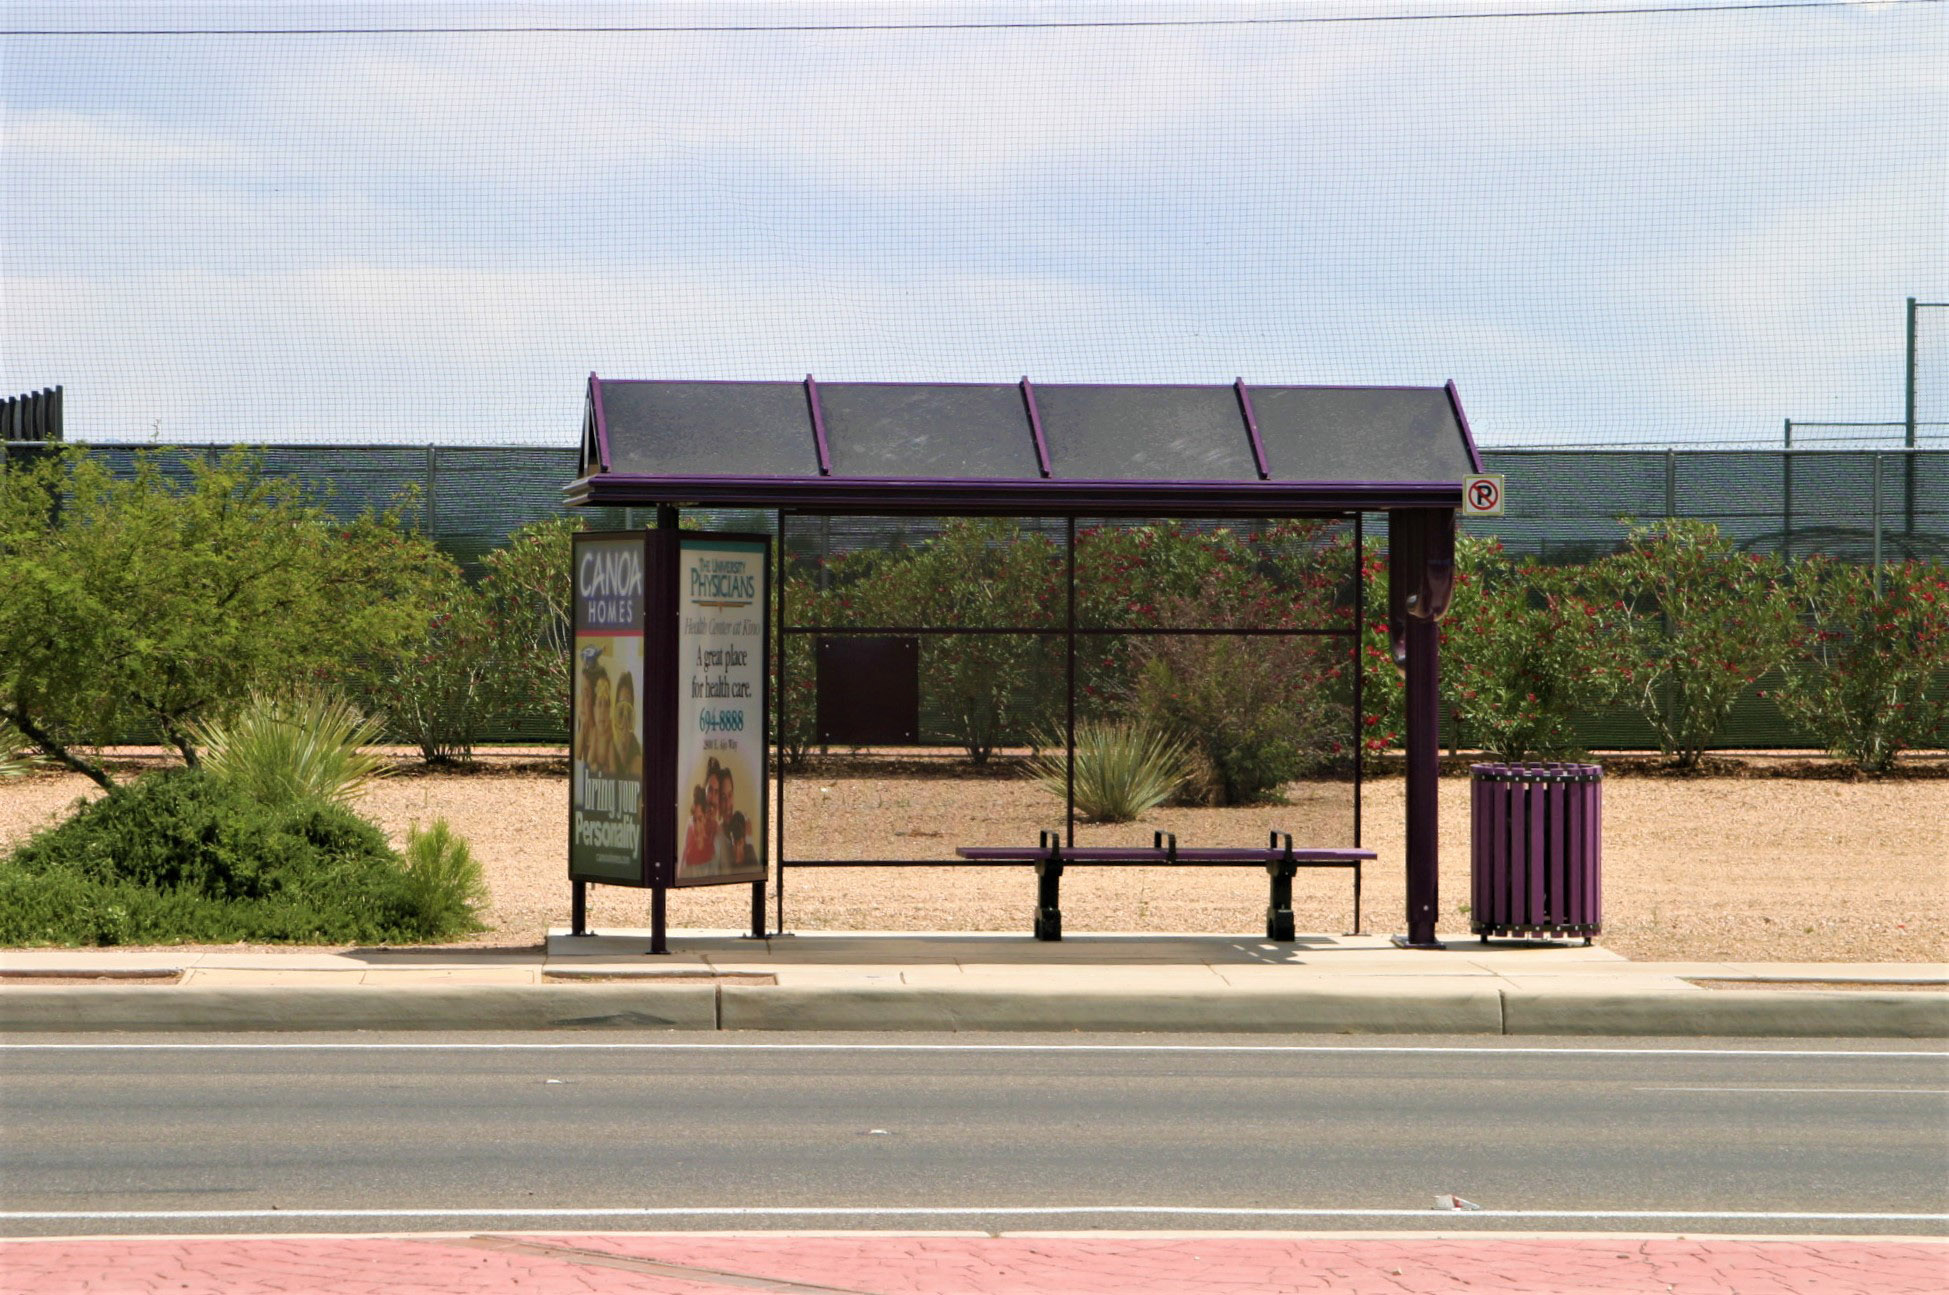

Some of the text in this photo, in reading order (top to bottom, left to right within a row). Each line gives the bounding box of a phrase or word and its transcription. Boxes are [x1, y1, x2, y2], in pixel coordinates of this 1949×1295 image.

[580, 551, 642, 597] CANOA
[699, 557, 746, 574] THE UNIVERSITY
[690, 567, 755, 598] PHYSICIANS
[588, 600, 633, 623] HOMES
[685, 616, 708, 635] Health
[696, 643, 748, 673] A great place
[692, 675, 752, 698] for health care.
[699, 707, 744, 734] 694-8888
[585, 769, 640, 819] bring your
[575, 811, 641, 859] Personality
